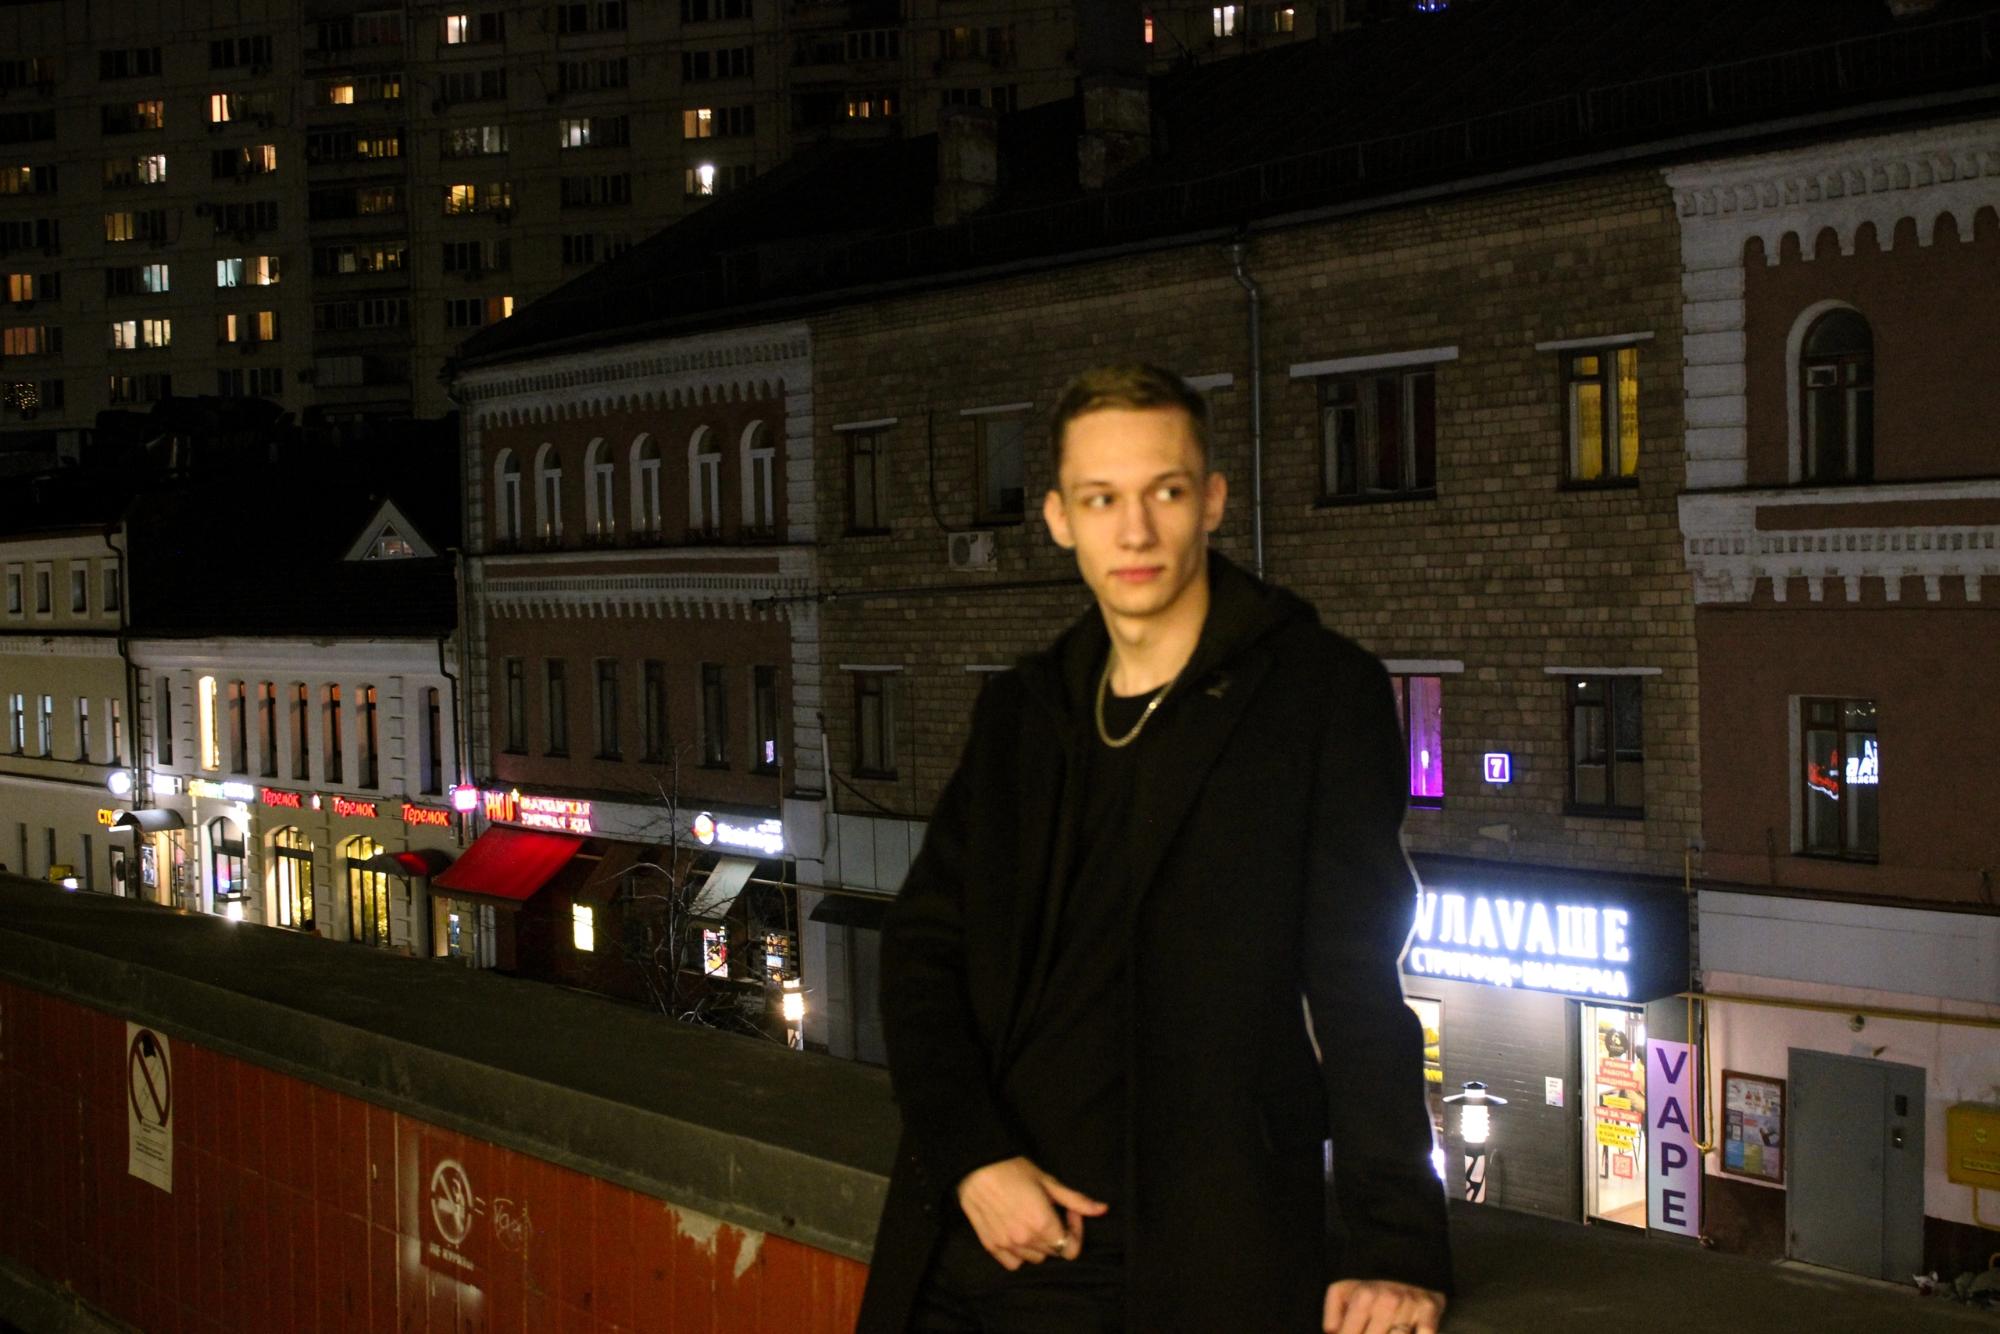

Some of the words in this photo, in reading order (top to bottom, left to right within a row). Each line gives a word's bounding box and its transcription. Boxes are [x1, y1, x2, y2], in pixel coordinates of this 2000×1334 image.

[1490, 758, 1503, 778] 7
[261, 788, 301, 808] Теремок
[333, 796, 377, 817] Теремок
[402, 803, 449, 826] Теремок
[1656, 1047, 1690, 1228] VAPE
